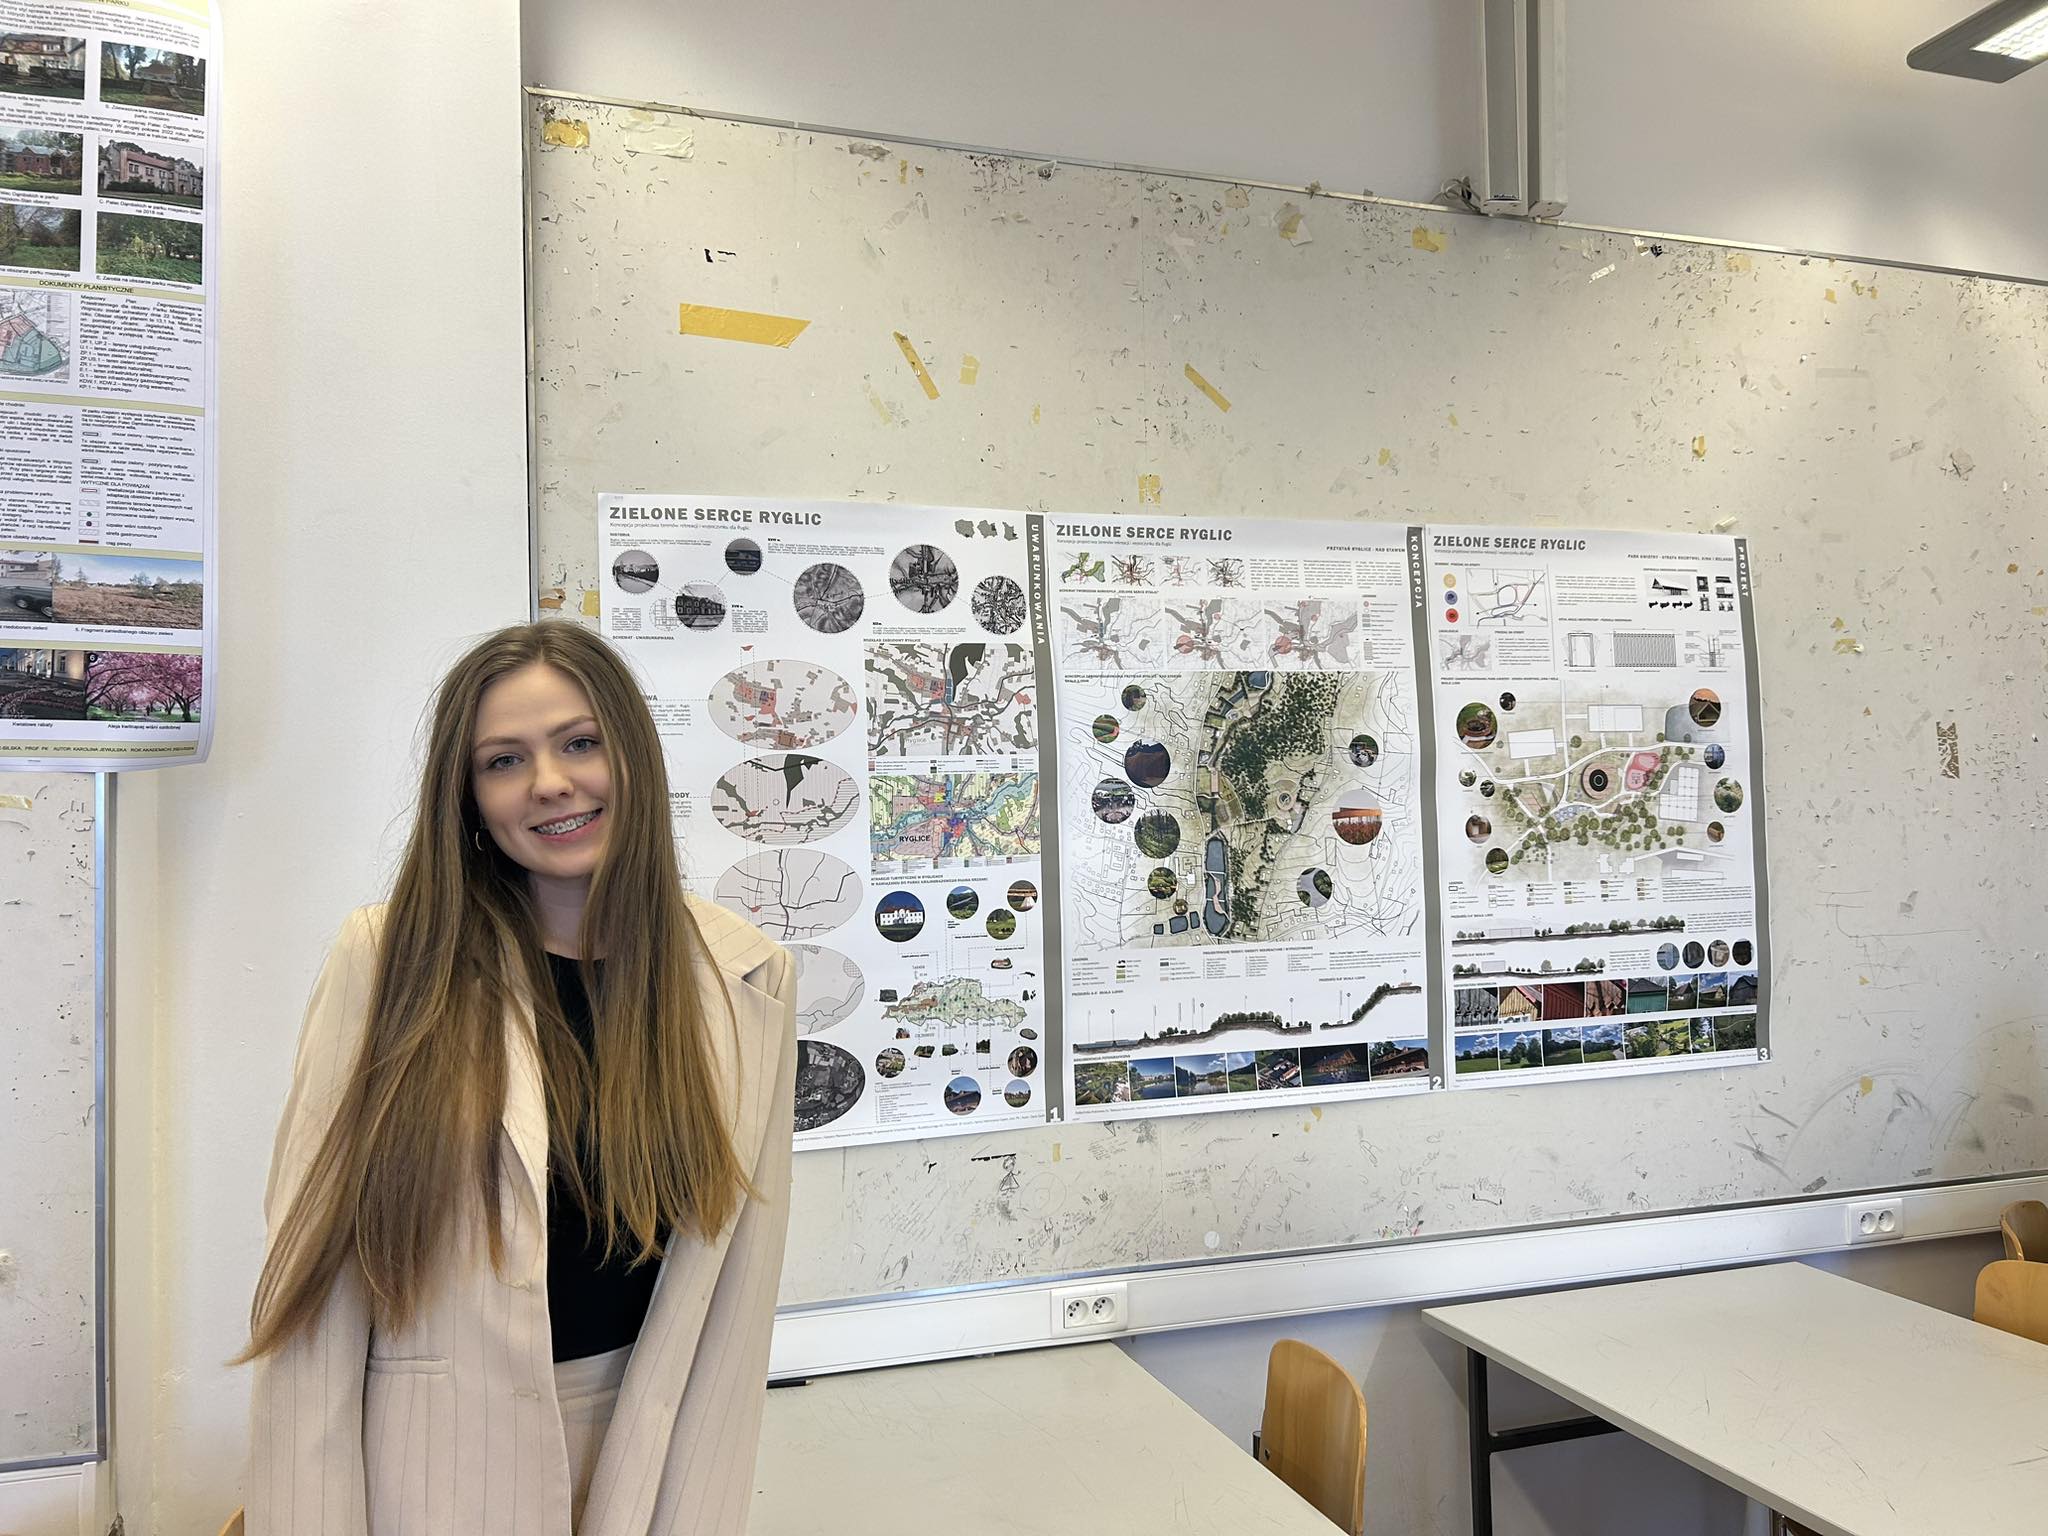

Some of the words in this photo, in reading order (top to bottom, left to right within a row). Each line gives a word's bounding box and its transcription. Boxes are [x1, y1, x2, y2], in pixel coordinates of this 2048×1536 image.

[39, 280, 83, 289] DOKUMENTY
[83, 284, 134, 294] PLANISTYCZNE
[609, 506, 688, 521] ZIELONE
[694, 508, 753, 523] SERCE
[759, 510, 823, 526] RYGLIC
[1056, 524, 1121, 538] ZIELONE
[1126, 526, 1175, 540] SERCE
[1180, 528, 1233, 542] RYGLIC
[1494, 537, 1536, 549] SERCE
[1541, 538, 1586, 551] RYGLIC
[1410, 535, 1423, 608] KONCEPCJA
[1738, 546, 1749, 597] PROJEKT
[1031, 524, 1045, 645] UWARUNKOWANIA
[899, 835, 931, 843] RYGLICE
[1760, 1048, 1769, 1060] 3
[1432, 1075, 1442, 1090] 2
[1050, 1106, 1061, 1122] 1
